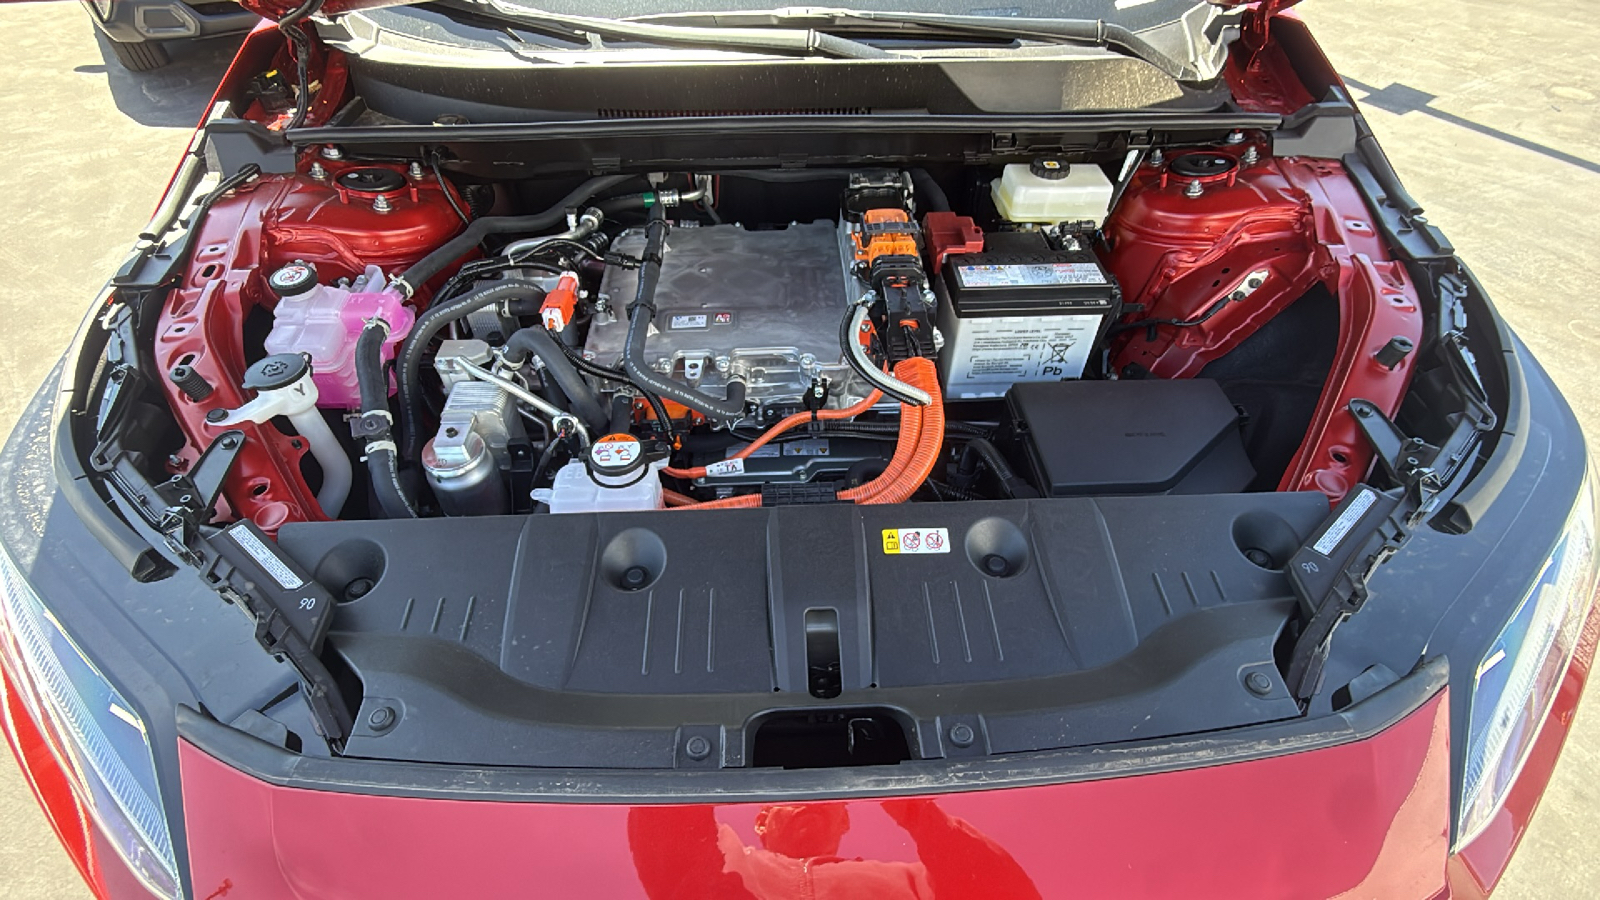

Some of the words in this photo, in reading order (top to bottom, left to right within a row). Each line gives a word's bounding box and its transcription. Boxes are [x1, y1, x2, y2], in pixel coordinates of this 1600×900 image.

[1042, 366, 1063, 376] Pb
[1301, 561, 1319, 574] 90
[298, 597, 316, 610] 90
